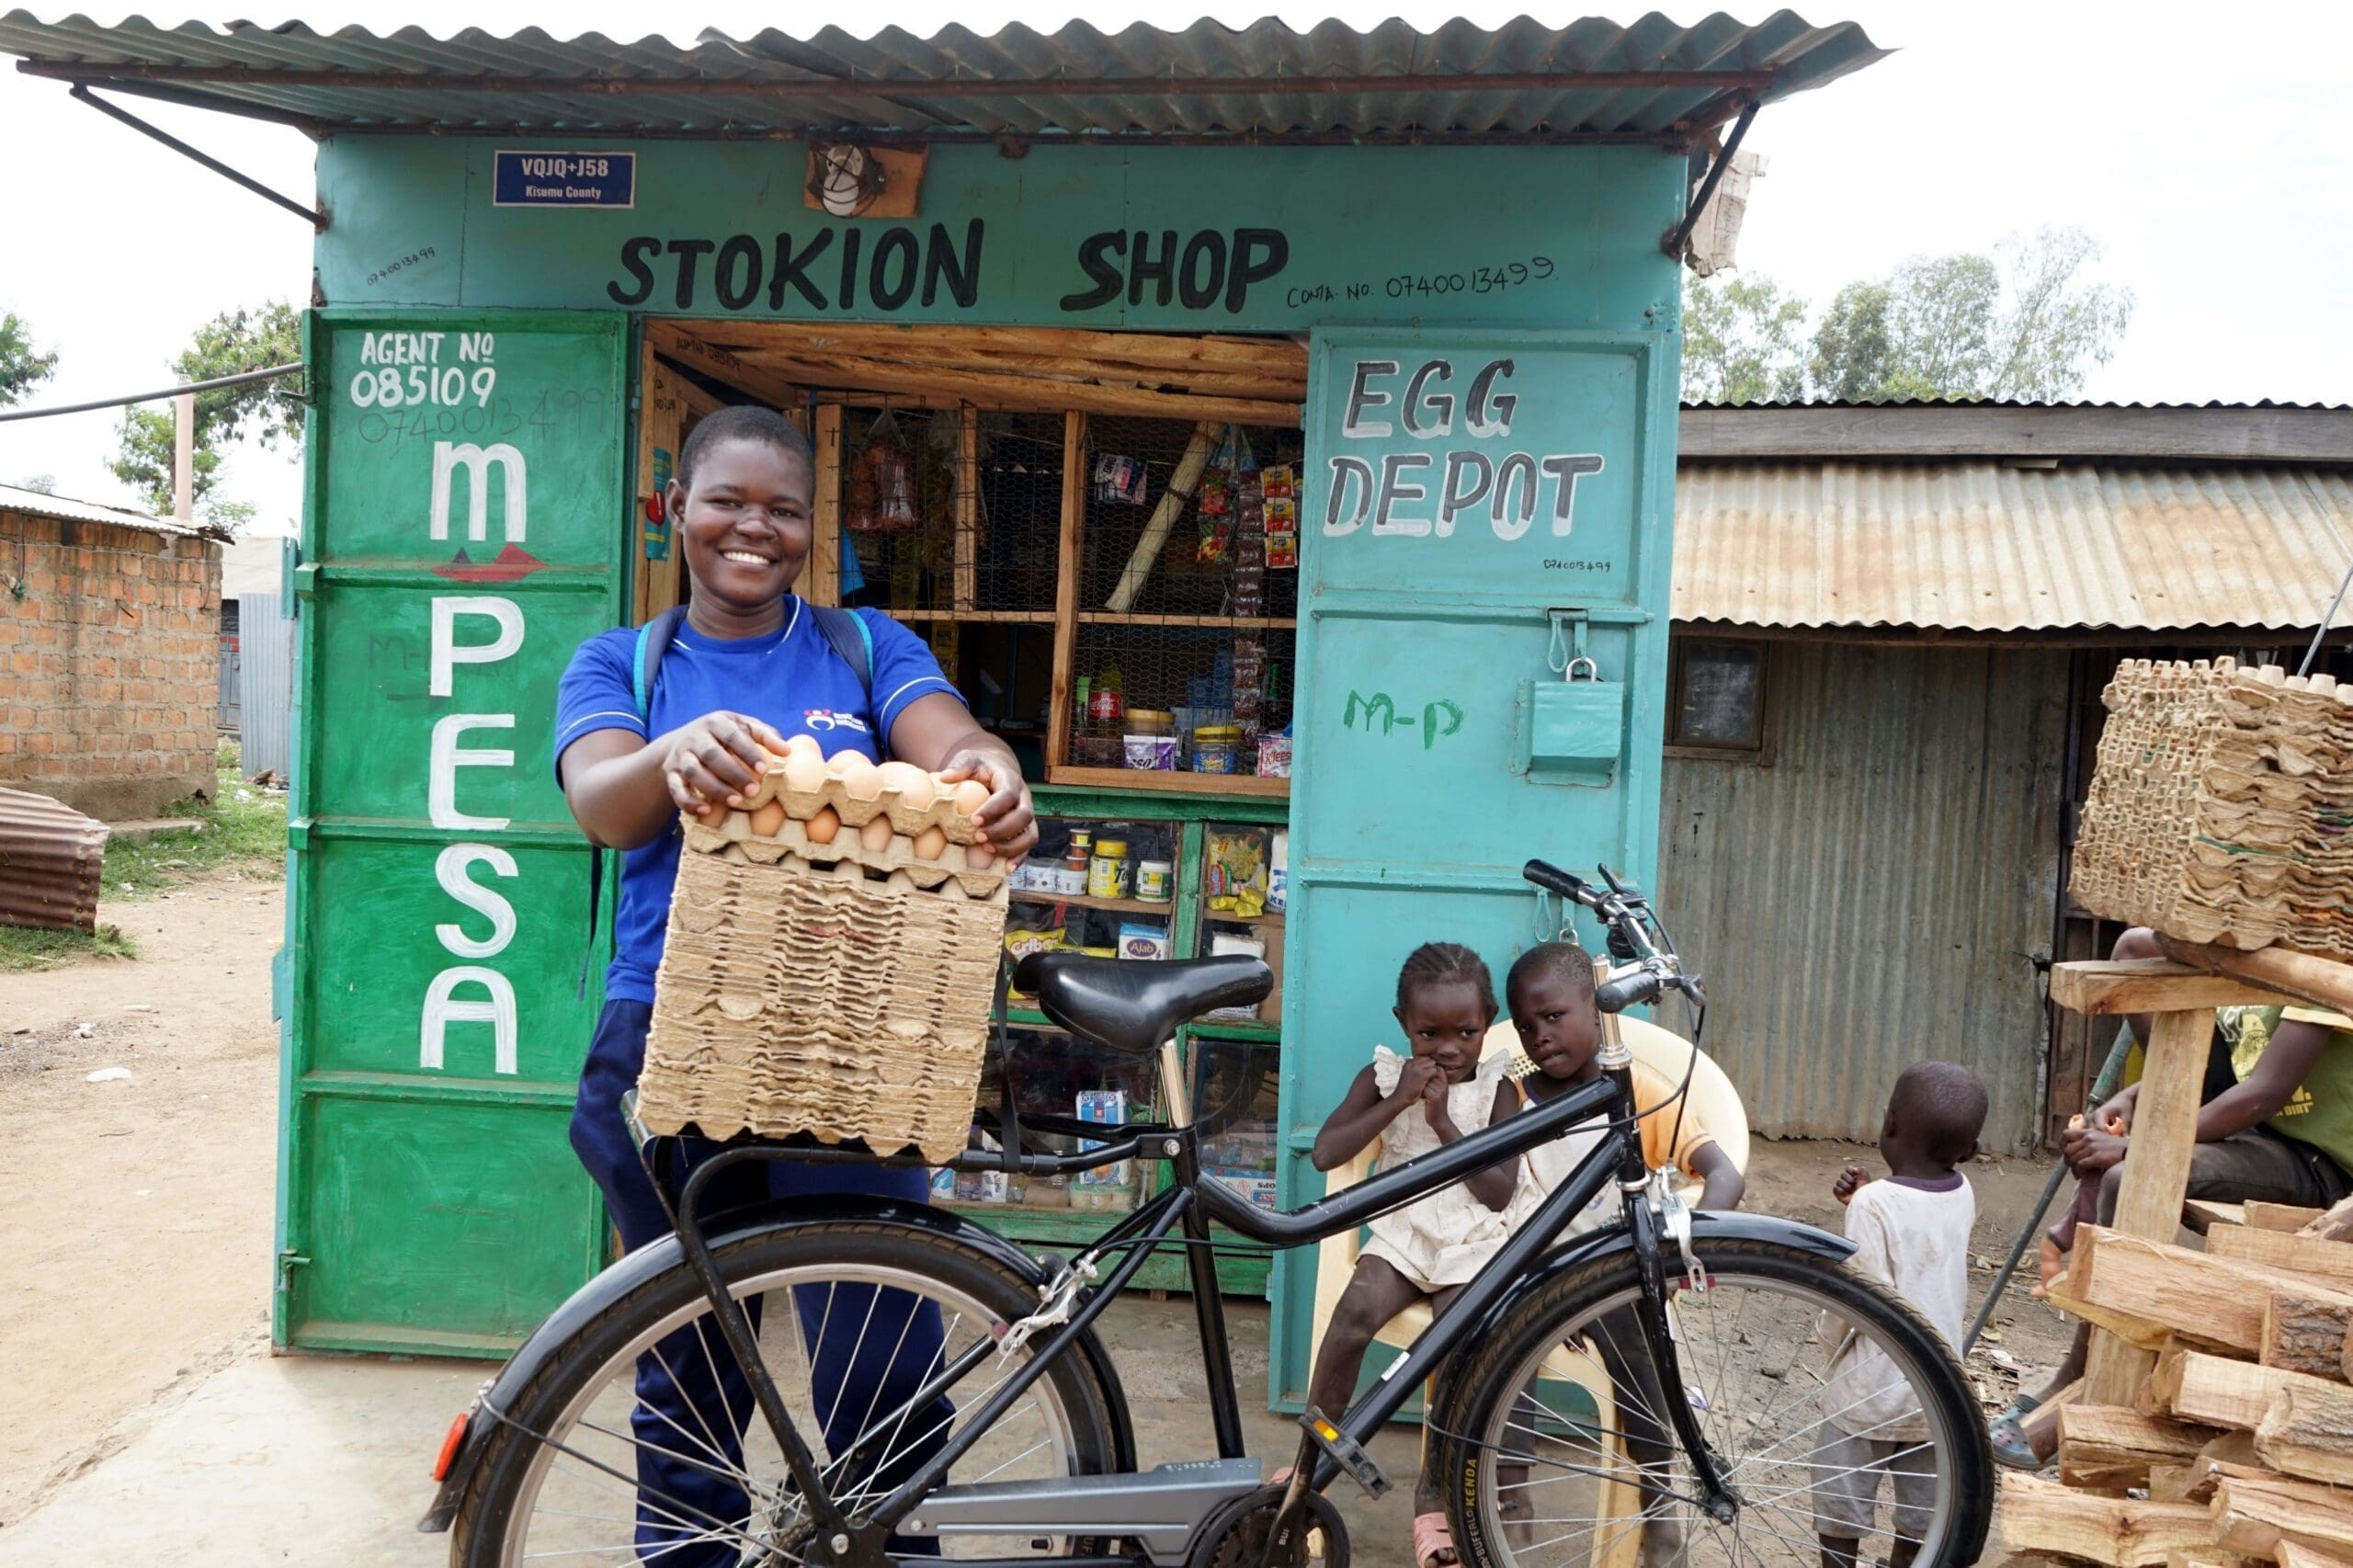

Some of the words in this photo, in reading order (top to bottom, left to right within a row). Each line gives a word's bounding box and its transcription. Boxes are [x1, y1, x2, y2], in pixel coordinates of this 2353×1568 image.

[521, 158, 608, 178] VQJQ+J58
[526, 186, 563, 198] Kisumu
[565, 187, 602, 199] County
[607, 218, 984, 311] STOKION
[1060, 228, 1289, 313] SHOP
[1386, 256, 1554, 298] 0740013499
[360, 333, 445, 365] AGENT
[350, 366, 496, 407] 085109
[1342, 358, 1518, 438] EGG
[1323, 451, 1605, 540] DEPOT
[1465, 1460, 1477, 1506] KENDA
